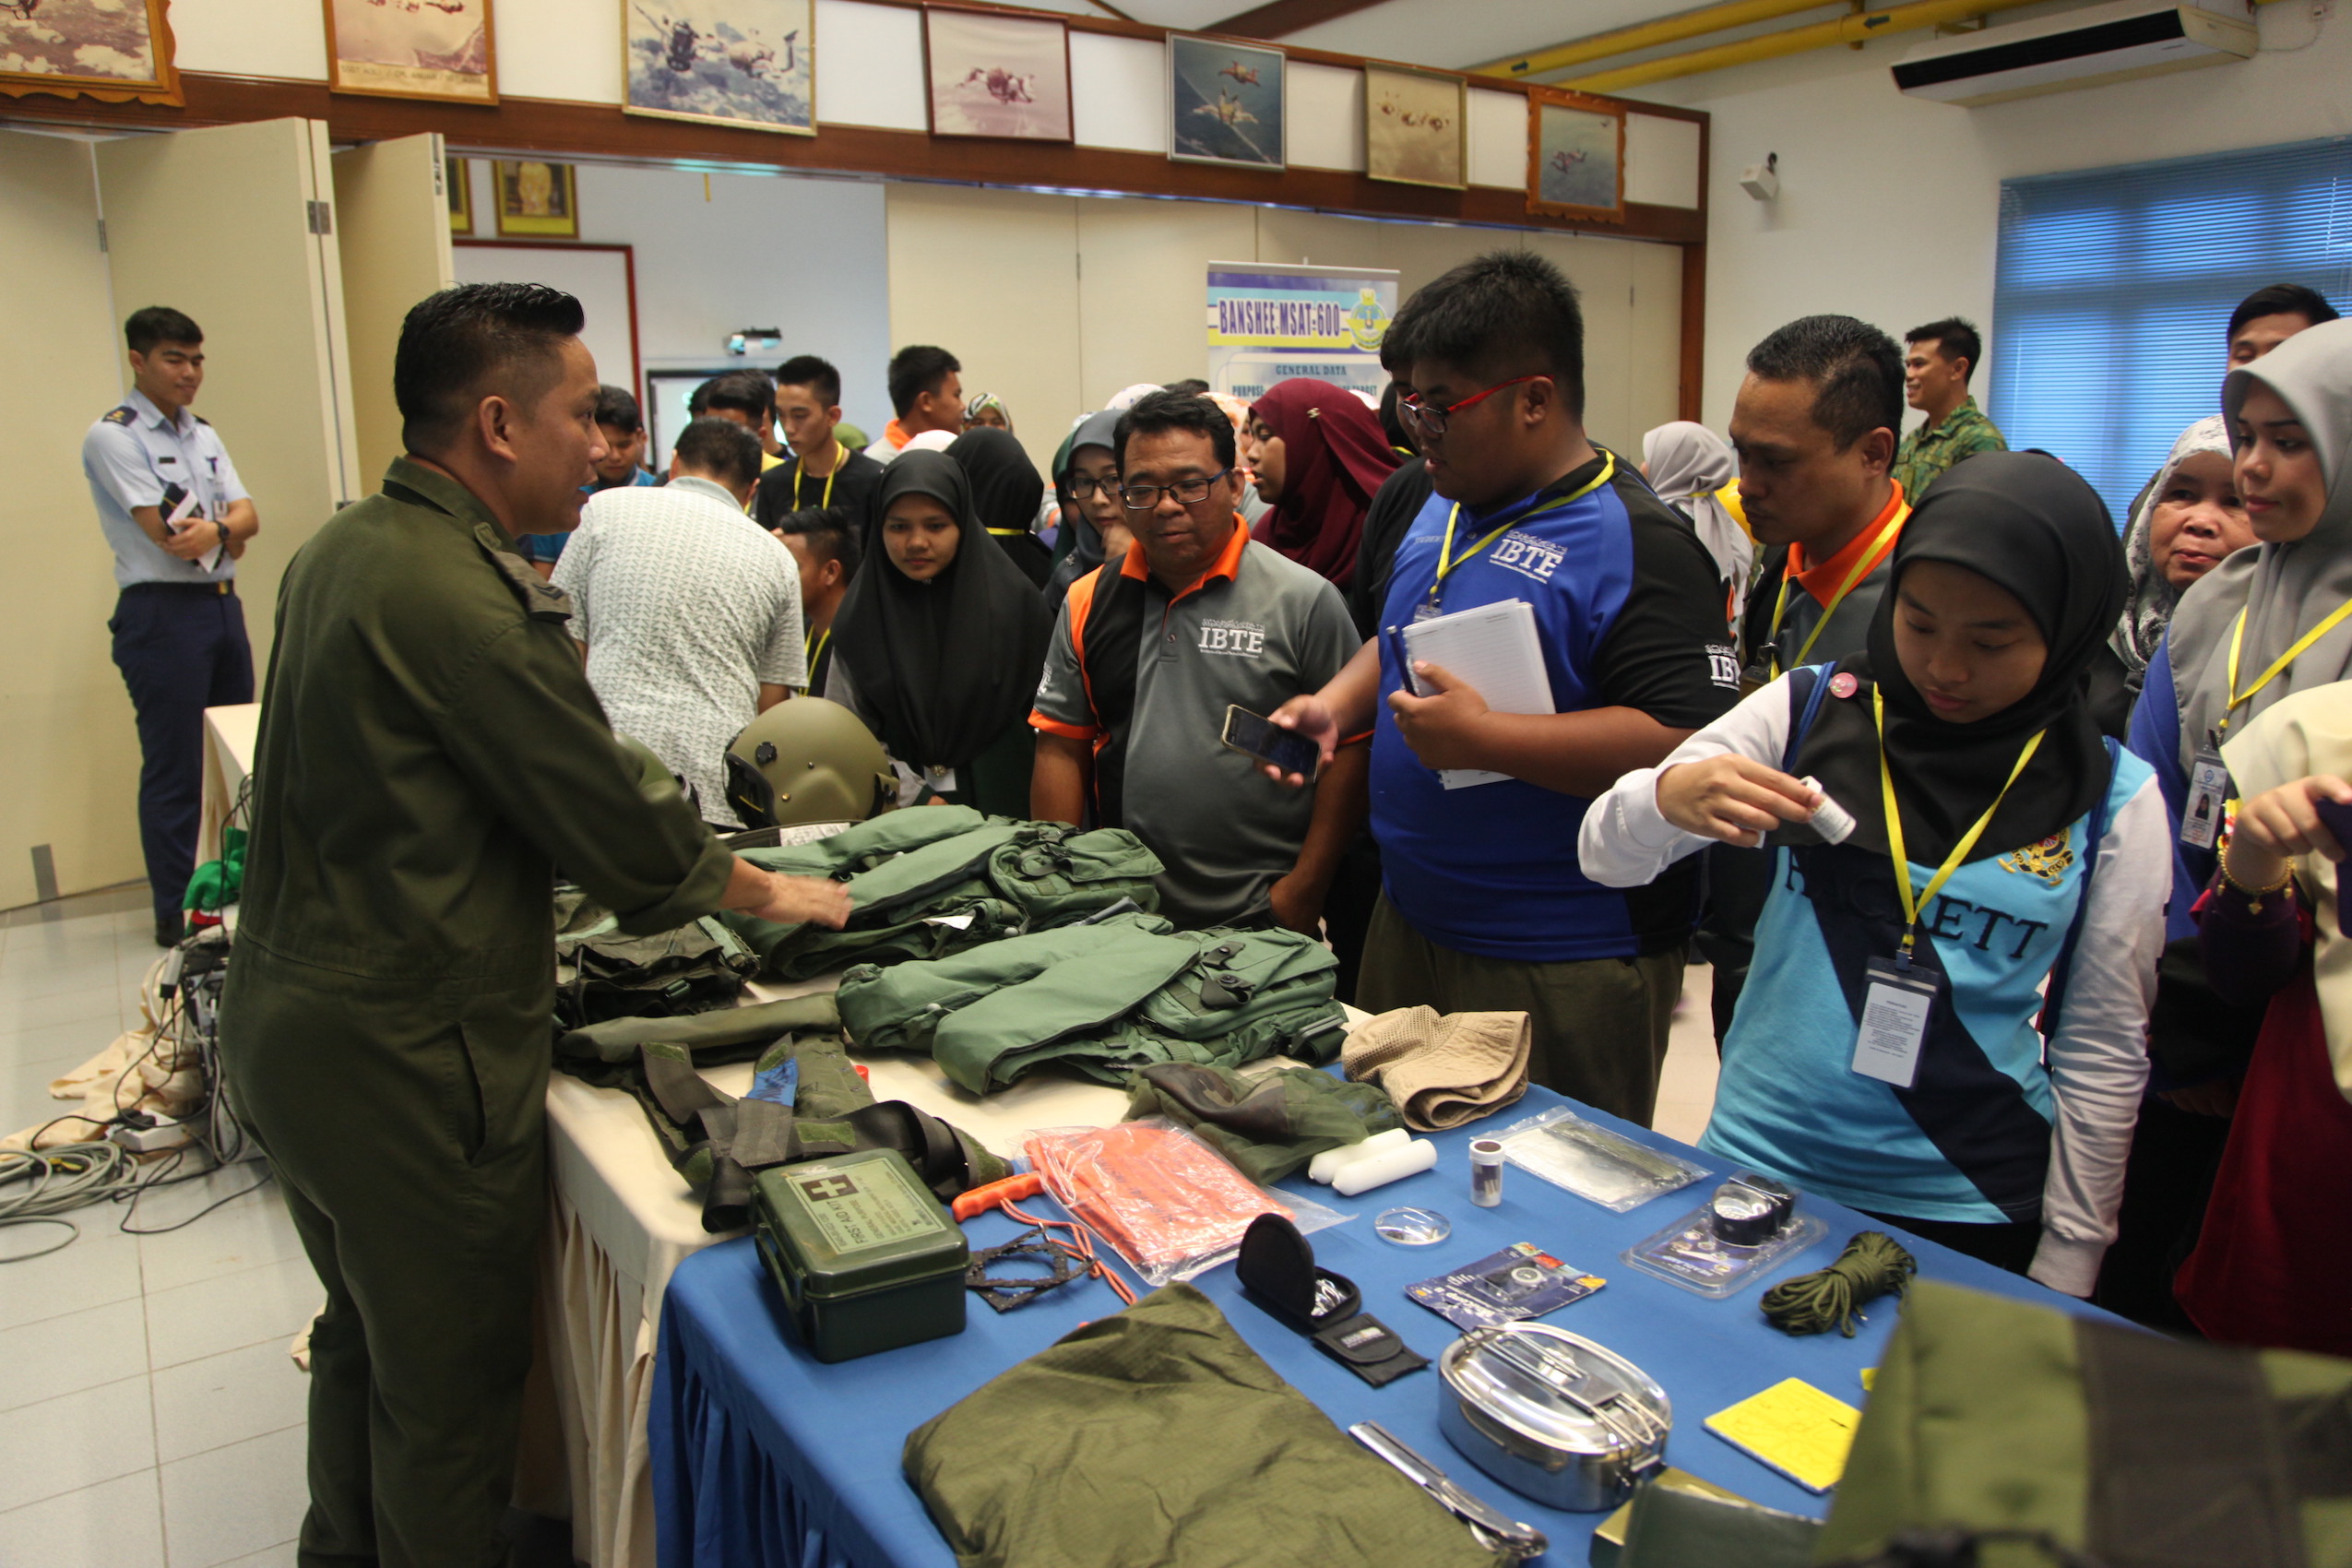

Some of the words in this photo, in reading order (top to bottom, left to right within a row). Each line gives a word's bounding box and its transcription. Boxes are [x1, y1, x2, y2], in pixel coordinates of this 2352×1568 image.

[1219, 300, 1276, 335] BANSHEE
[1279, 302, 1340, 337] MSAT-600
[1276, 365, 1321, 375] GENERAL
[1323, 366, 1347, 375] DATA
[1490, 539, 1563, 577] IBTE
[1198, 627, 1265, 654] IBTE
[826, 1200, 844, 1211] KIT
[835, 1211, 853, 1223] AID
[843, 1223, 868, 1244] FIRST
